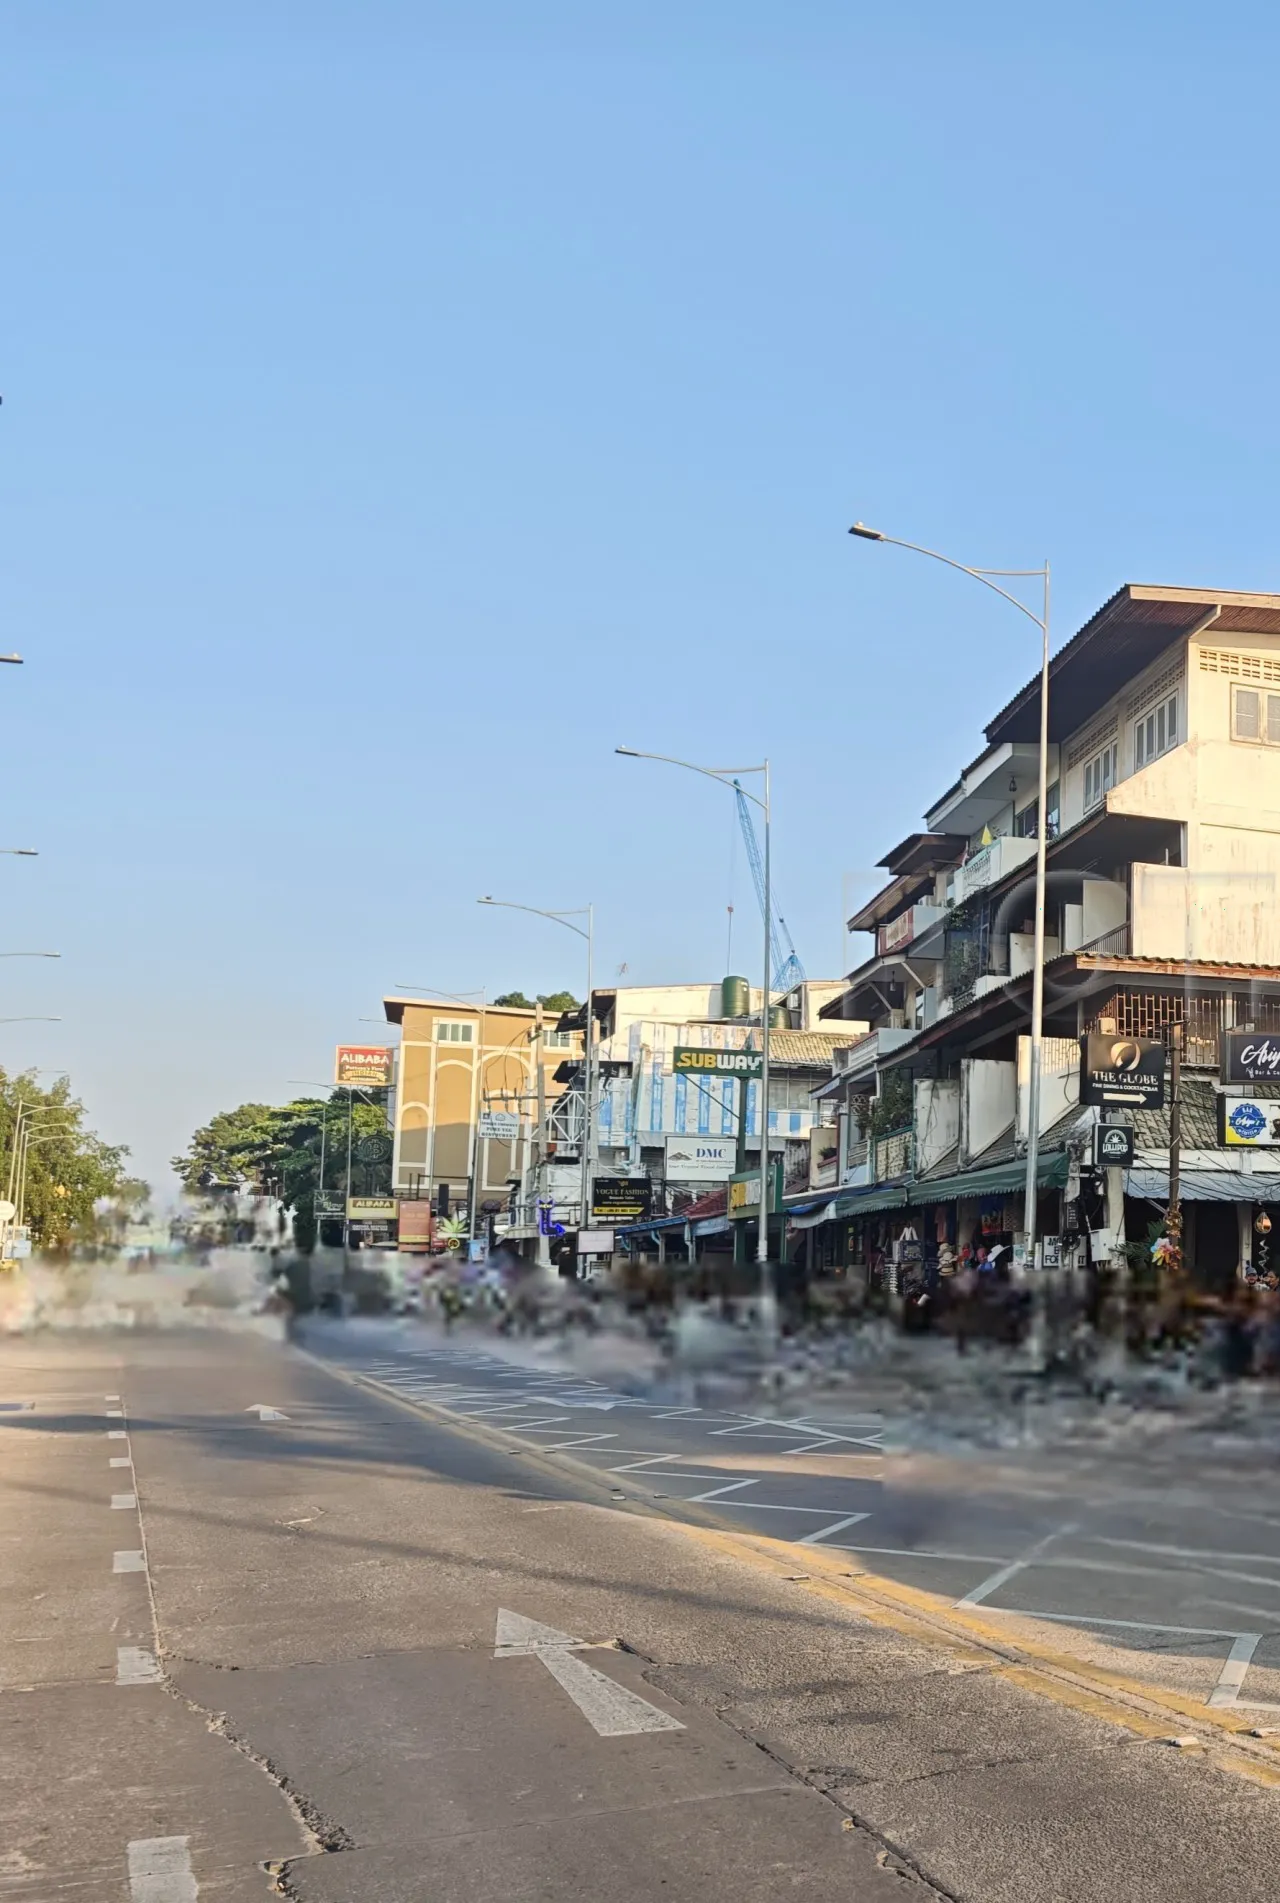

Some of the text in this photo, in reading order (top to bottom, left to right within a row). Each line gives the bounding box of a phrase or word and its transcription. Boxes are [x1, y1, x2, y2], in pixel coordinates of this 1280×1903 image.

[341, 1053, 390, 1065] ALIBABA
[676, 1053, 763, 1071] SUBWAY
[1092, 1070, 1159, 1085] THE GLOBE
[696, 1148, 727, 1158] DMC
[355, 1200, 391, 1208] ALIBABA
